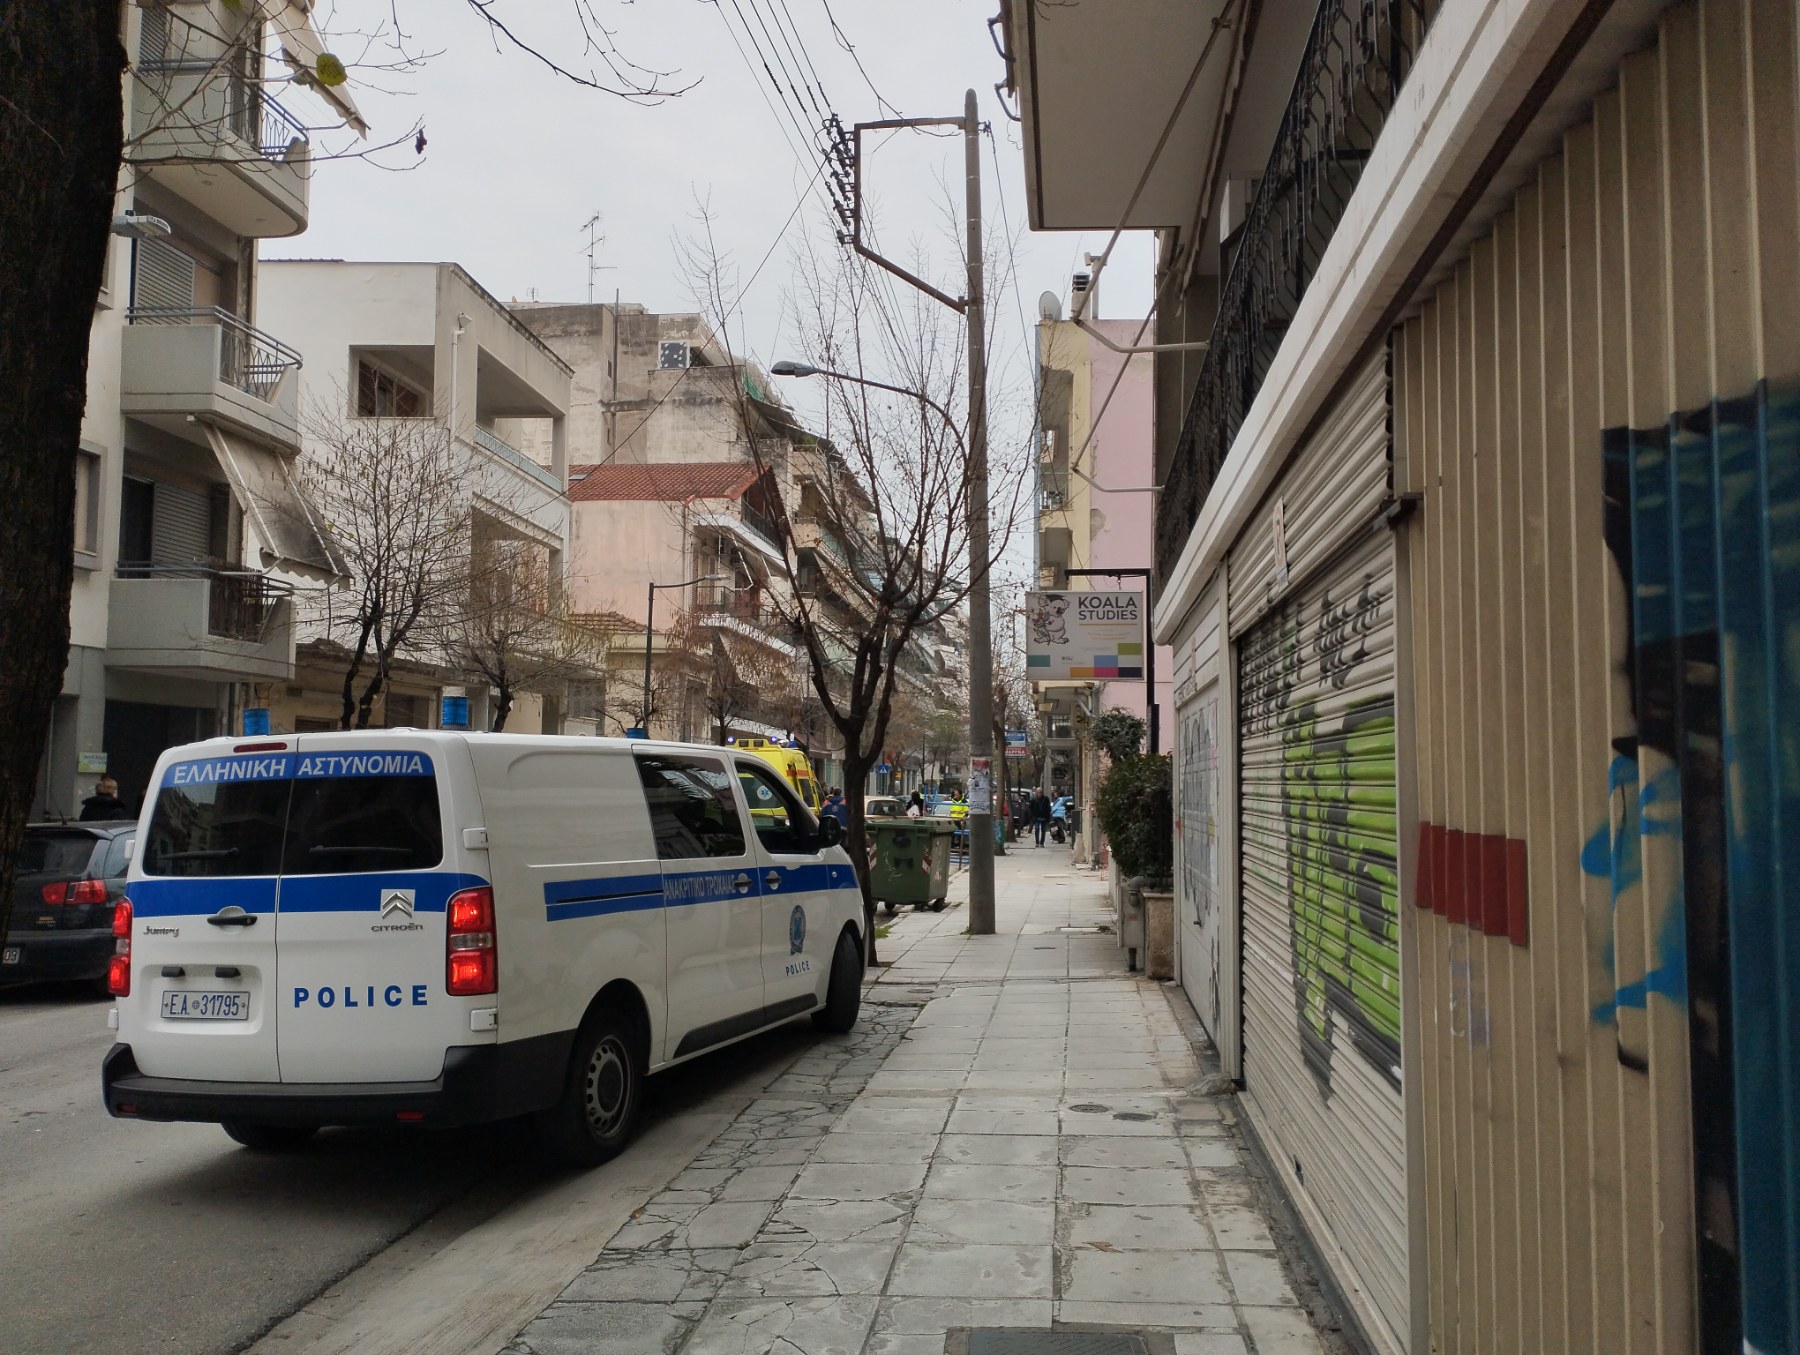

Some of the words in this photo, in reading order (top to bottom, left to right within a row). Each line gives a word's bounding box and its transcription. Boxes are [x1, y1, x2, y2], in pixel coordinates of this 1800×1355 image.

[1078, 596, 1137, 609] KOALA
[1079, 610, 1138, 620] STUDIES
[174, 758, 287, 785] ΕΛΛΗΝΙΚΗ
[298, 755, 424, 776] ΑΣΤΥΝΟΜΙΑ
[785, 960, 811, 977] POLICE
[200, 994, 240, 1016] 31795
[294, 984, 428, 1008] POLICE
